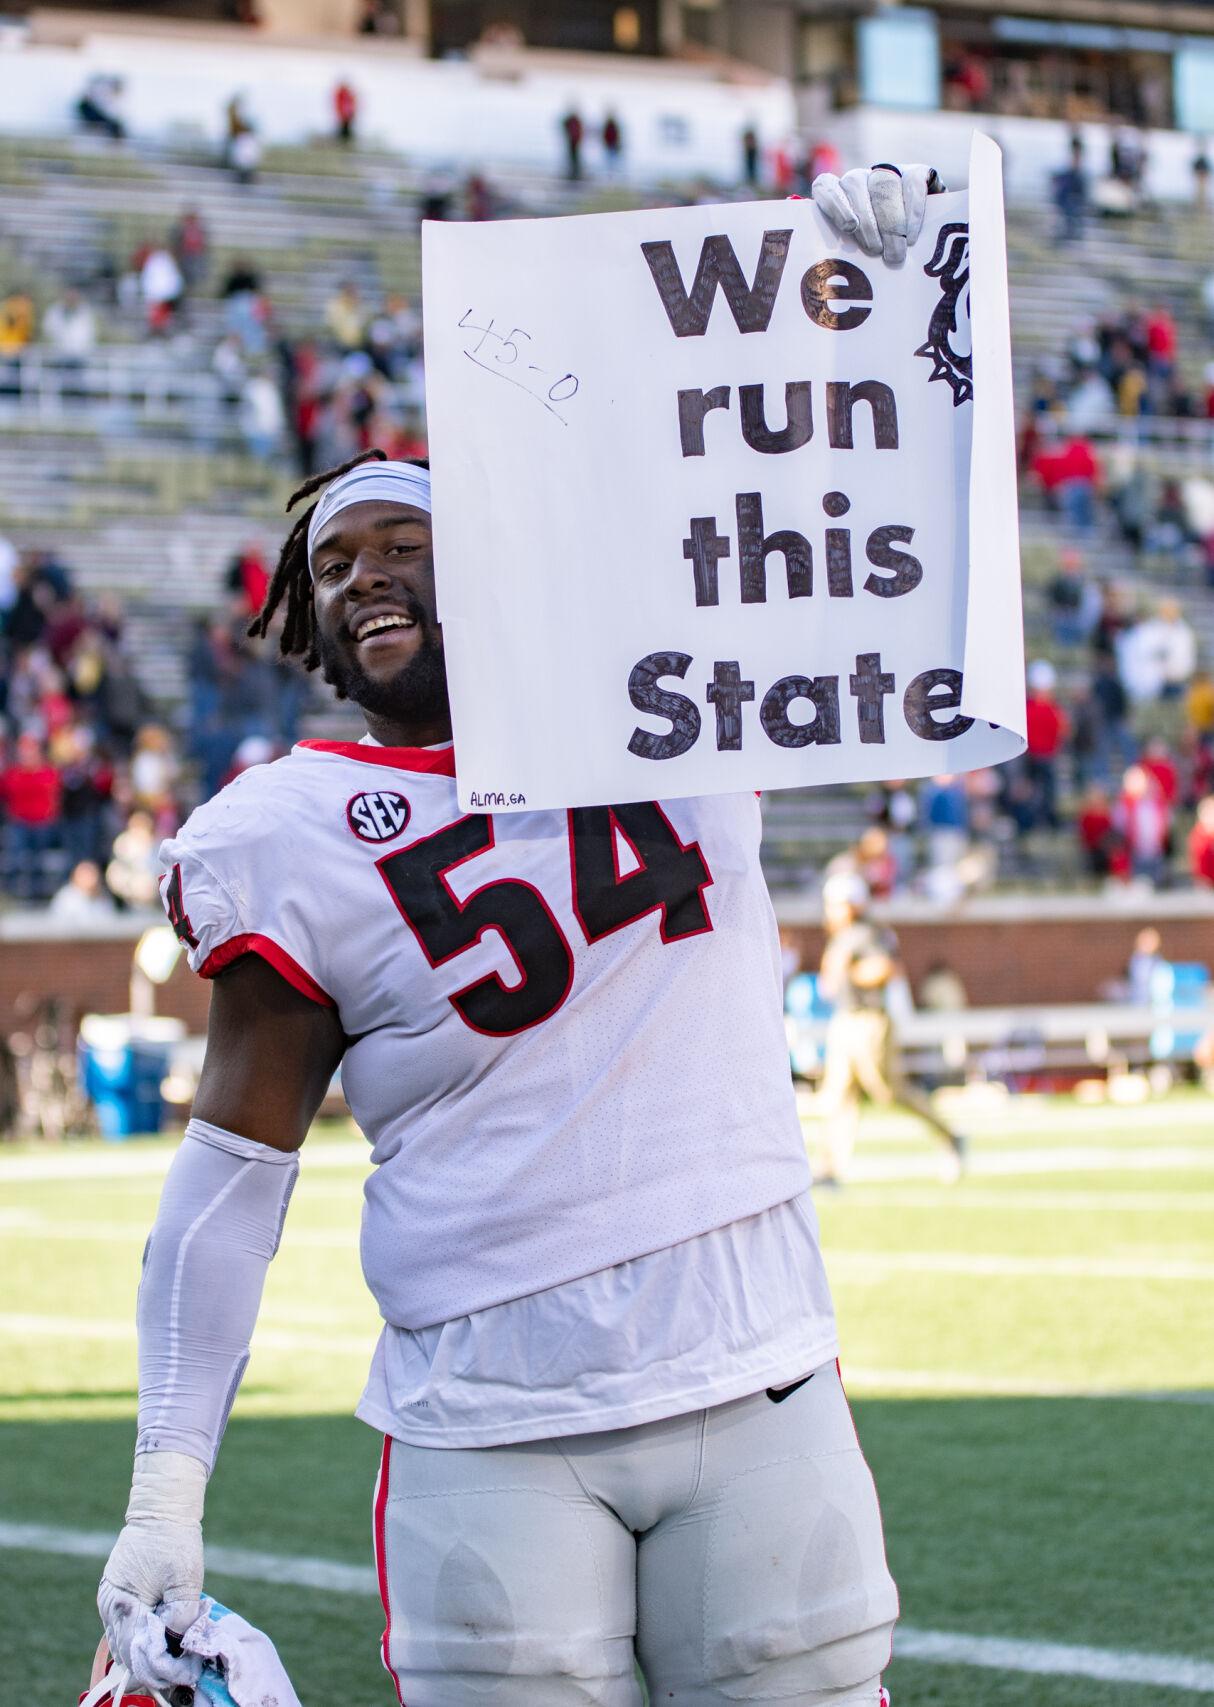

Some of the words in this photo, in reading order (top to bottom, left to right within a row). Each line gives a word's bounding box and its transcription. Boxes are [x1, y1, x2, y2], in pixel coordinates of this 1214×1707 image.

[640, 229, 874, 337] We
[458, 308, 579, 402] 45-0
[677, 380, 899, 457] run
[683, 491, 923, 607] this
[351, 792, 406, 840] SEC
[374, 800, 714, 1037] 54
